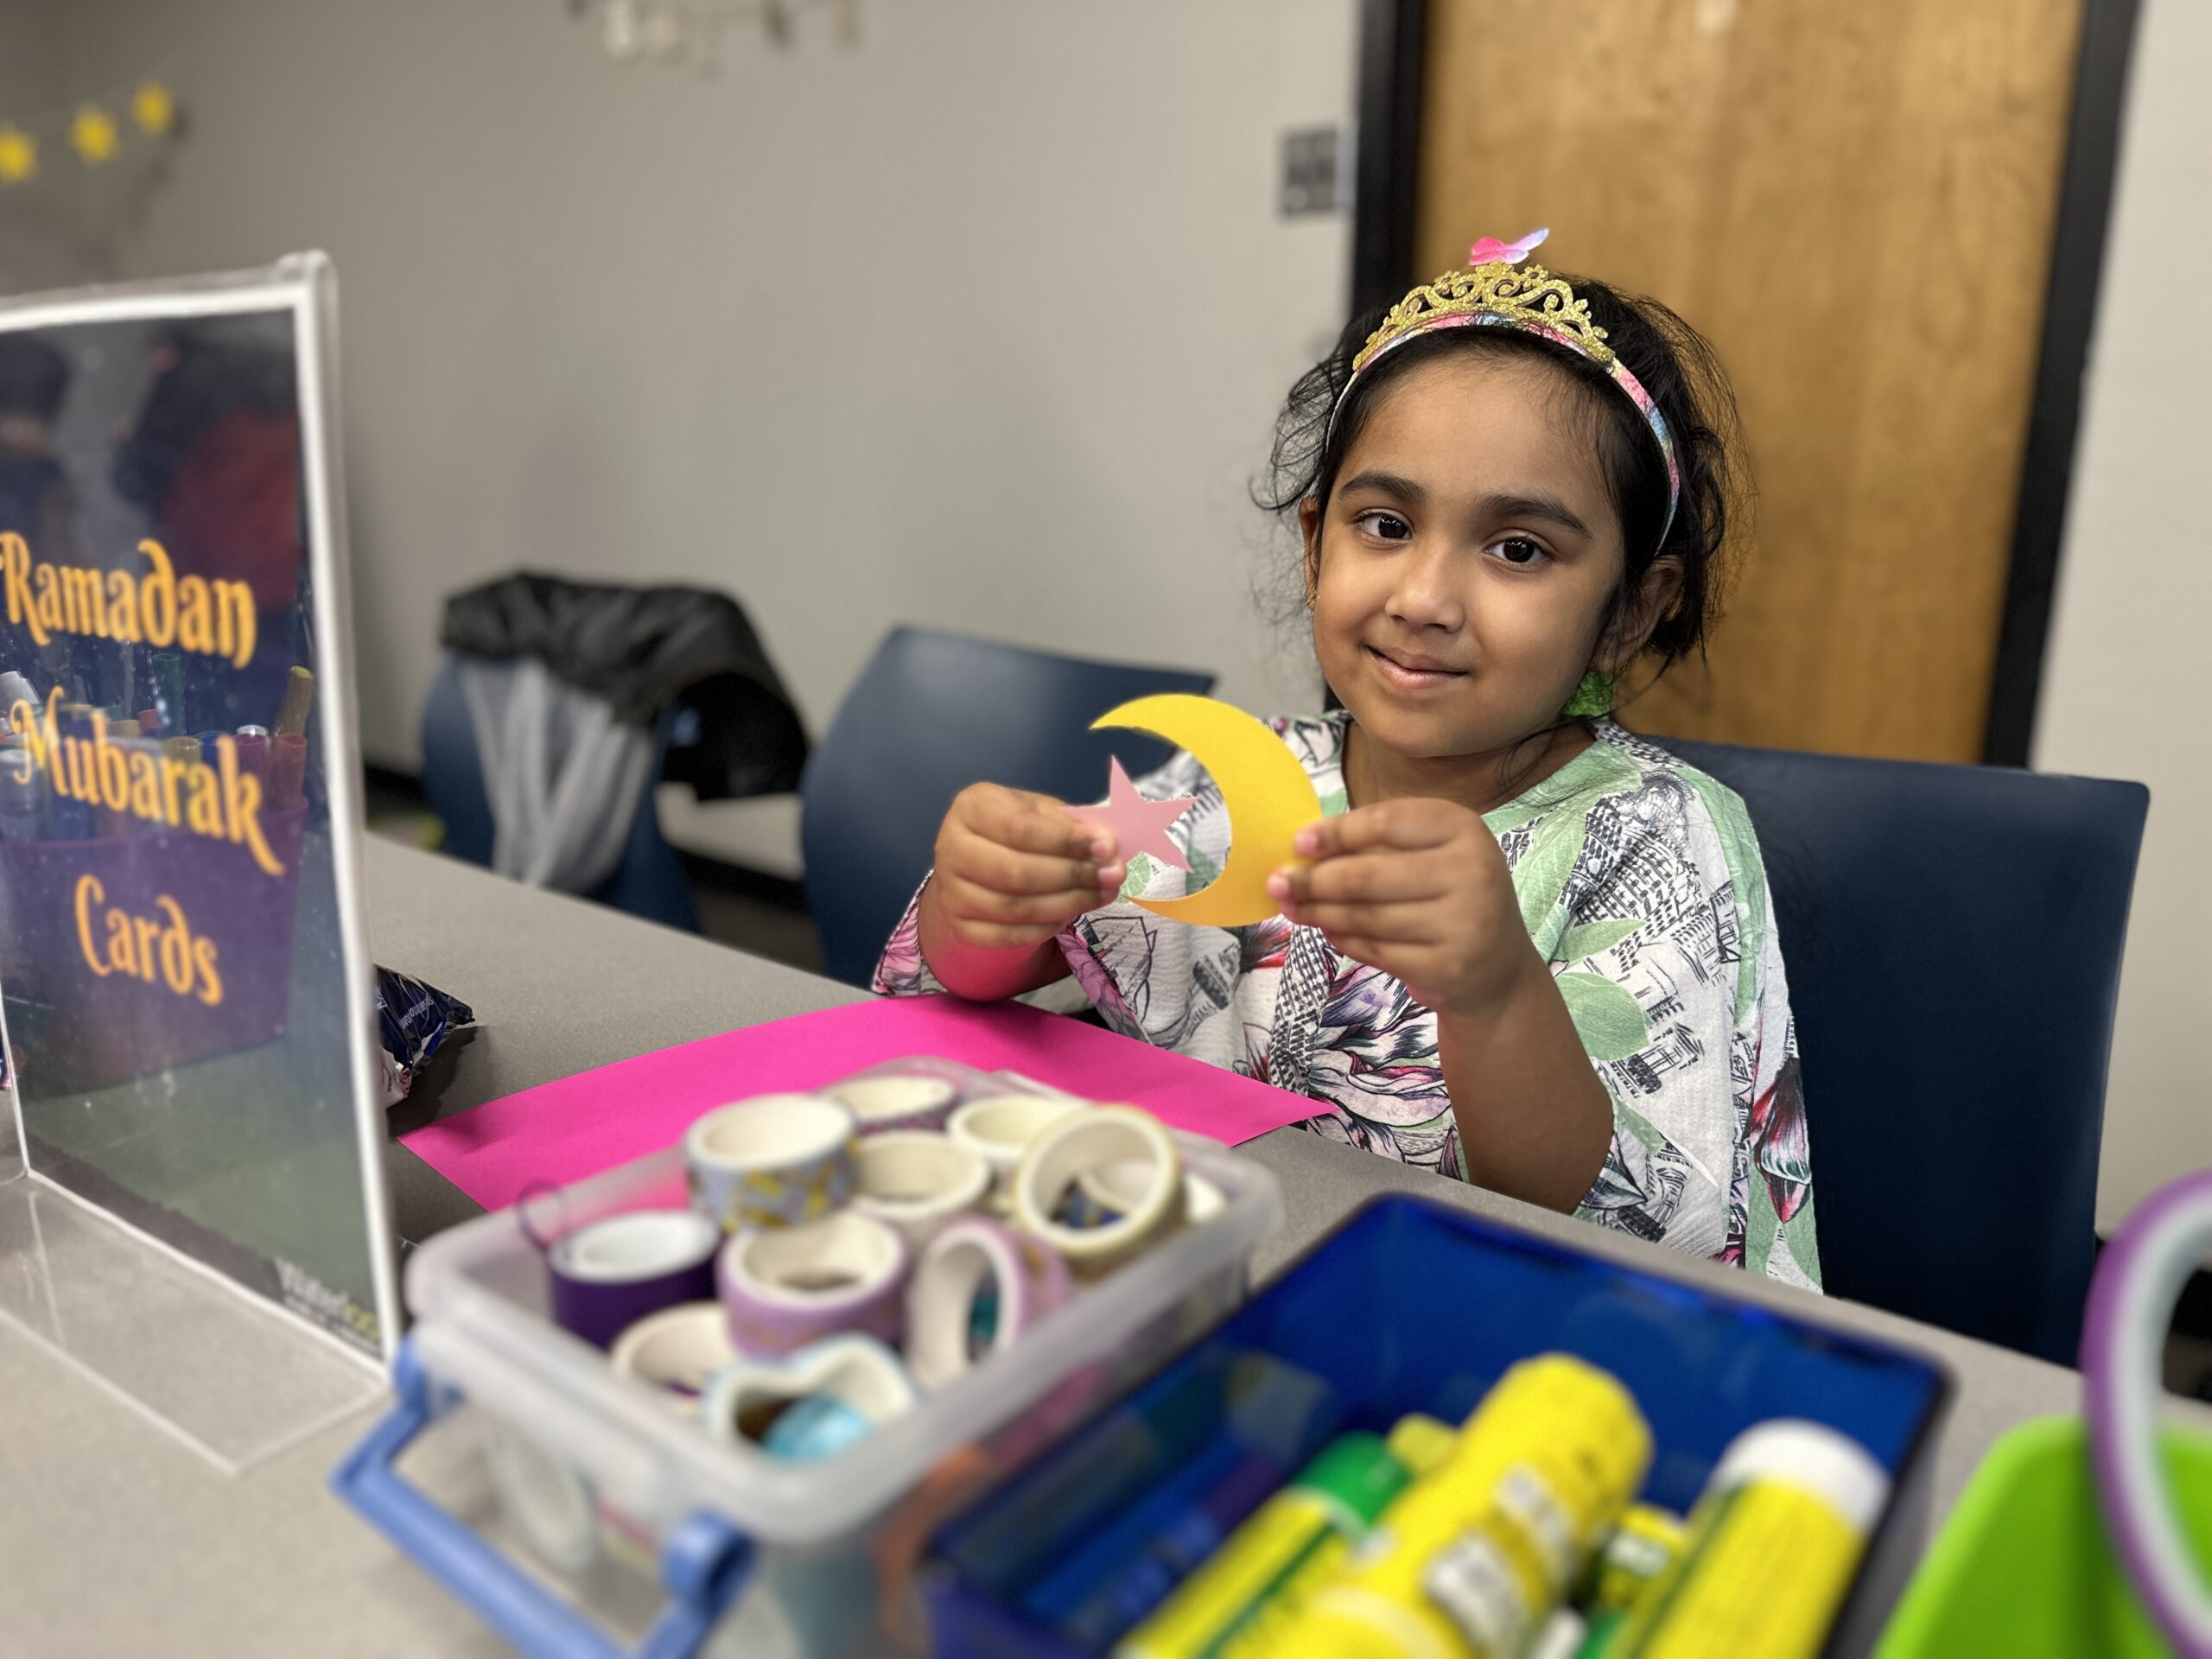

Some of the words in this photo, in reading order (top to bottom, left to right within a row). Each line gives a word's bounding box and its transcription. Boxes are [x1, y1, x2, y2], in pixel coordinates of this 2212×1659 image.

[0, 531, 257, 669] Ramadan
[10, 686, 286, 876] Mubarak
[74, 874, 224, 1006] Cards
